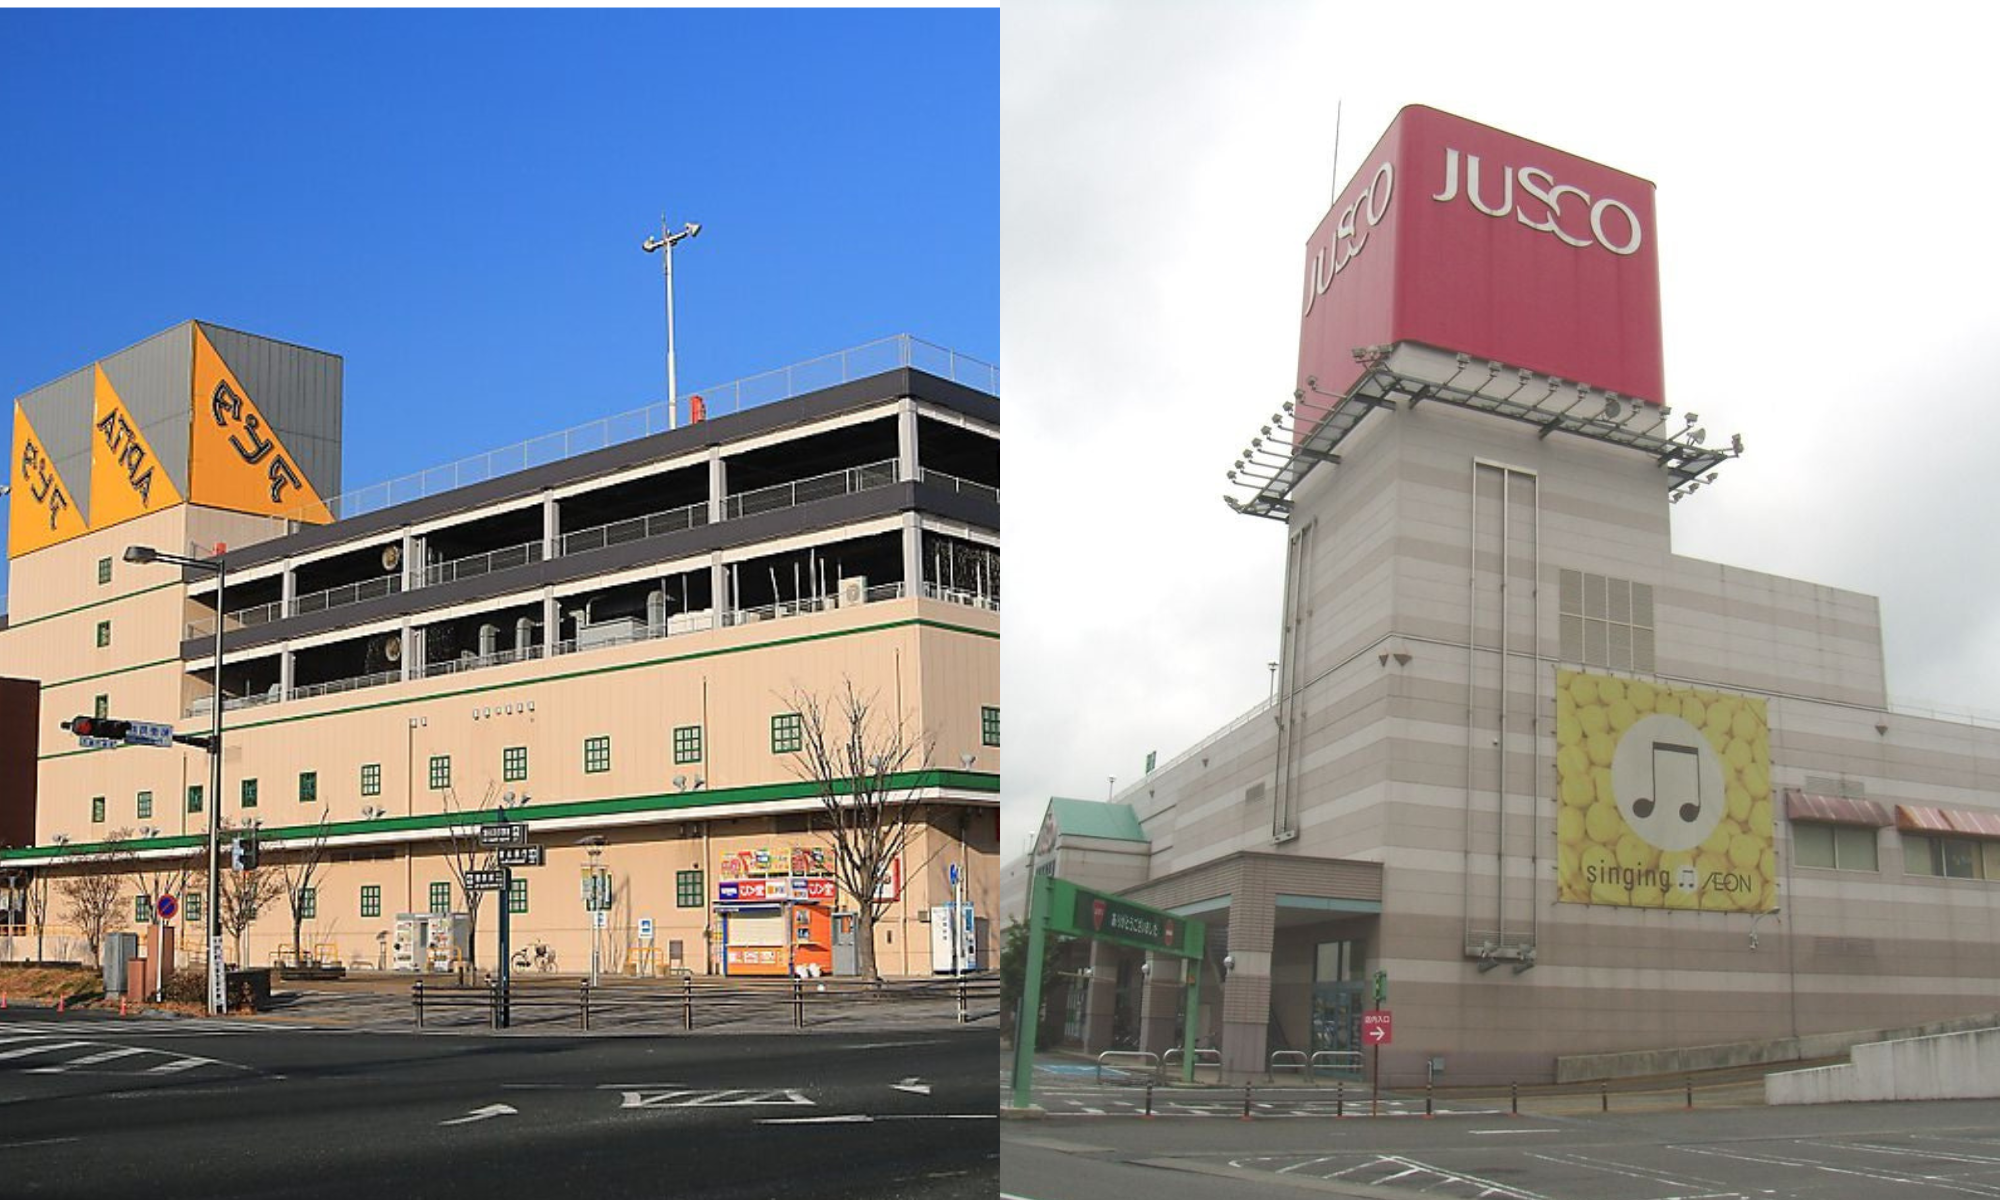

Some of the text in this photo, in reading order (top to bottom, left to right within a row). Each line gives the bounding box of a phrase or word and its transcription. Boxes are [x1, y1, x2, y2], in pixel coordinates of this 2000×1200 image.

[1305, 161, 1395, 317] JUSCO
[1433, 147, 1642, 255] JUSCO
[1587, 859, 1671, 892] singing
